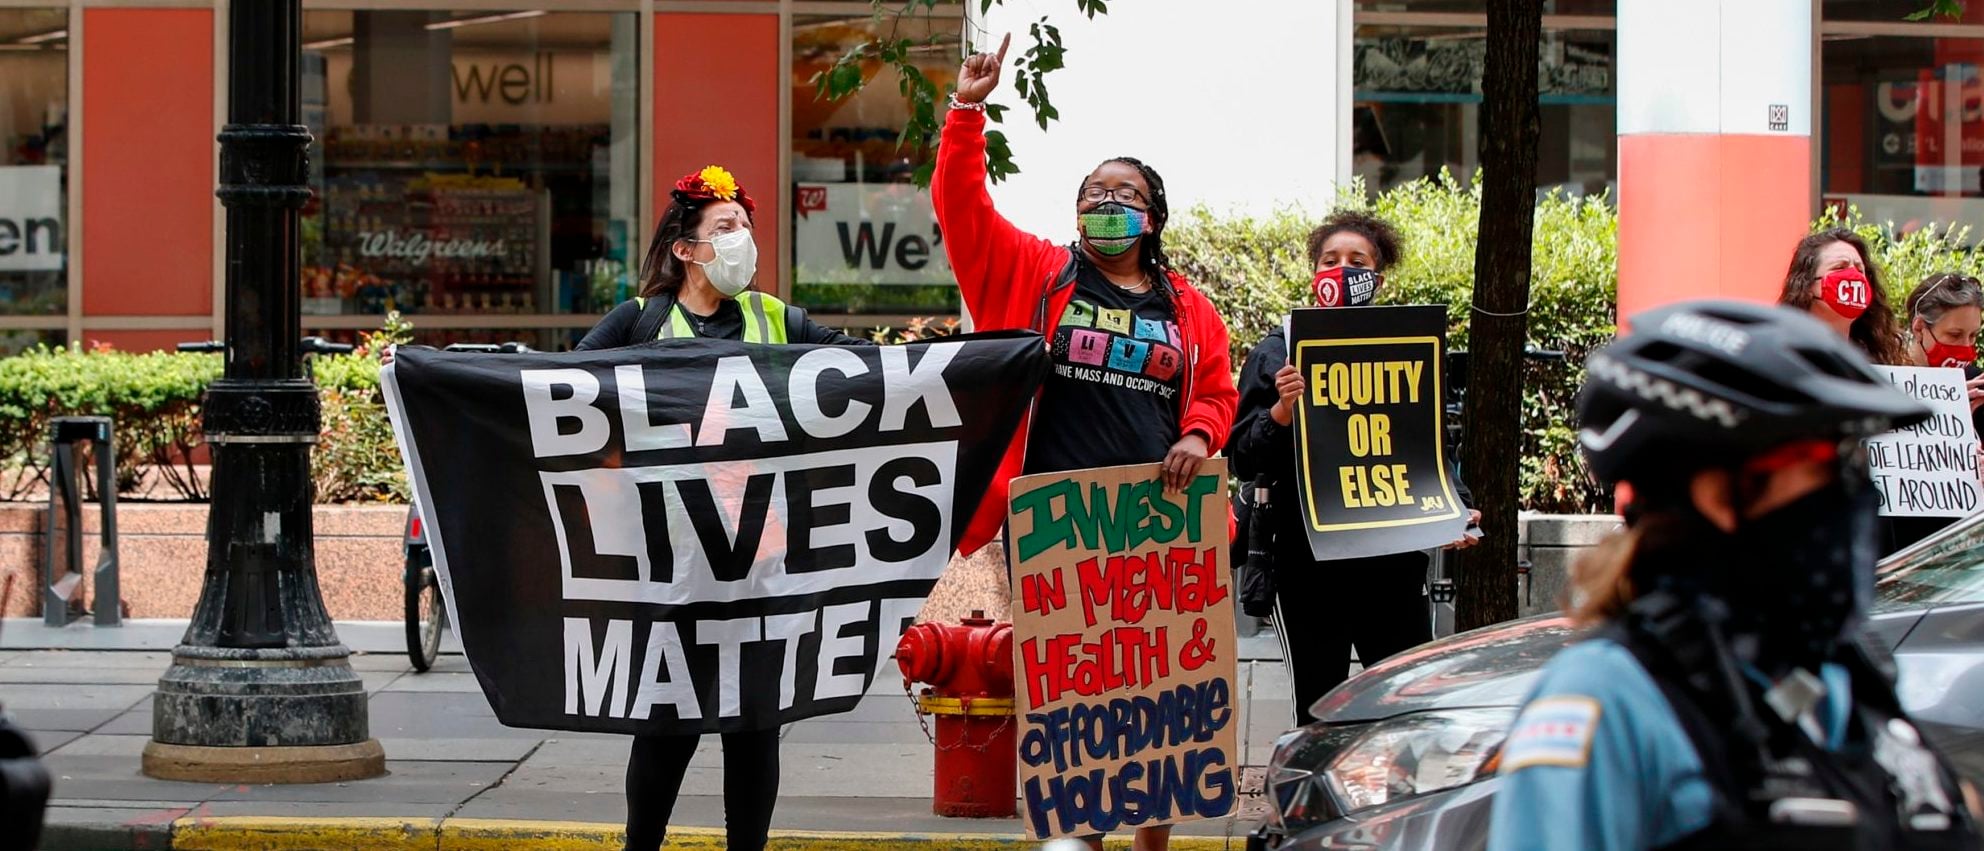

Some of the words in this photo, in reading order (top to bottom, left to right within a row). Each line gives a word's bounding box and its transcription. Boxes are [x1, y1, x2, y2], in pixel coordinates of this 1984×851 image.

[453, 52, 552, 105] well
[356, 230, 508, 266] Walgreens
[836, 221, 945, 271] We'
[1348, 271, 1373, 286] BLACK
[1352, 281, 1372, 294] LIVES
[1838, 279, 1867, 304] CTU
[1081, 335, 1095, 351] Li
[1125, 342, 1136, 358] V
[520, 342, 965, 459] BLACK
[1074, 367, 1102, 383] MASS
[1102, 372, 1123, 386] AND
[1126, 376, 1161, 393] OCCUPY
[1311, 360, 1424, 410] EQUITY
[1904, 373, 1961, 401] please
[1347, 414, 1392, 457] OR
[1868, 441, 1896, 470] OTE
[1896, 441, 1980, 481] LEARNING
[1339, 464, 1415, 508] ELSE
[1873, 474, 1892, 513] ST
[1899, 477, 1977, 513] AROUND
[552, 456, 941, 584] LIVES
[1011, 474, 1219, 563] INVEST
[1021, 567, 1067, 616] IN
[1179, 617, 1216, 671] &
[1025, 747, 1235, 839] HOUSING
